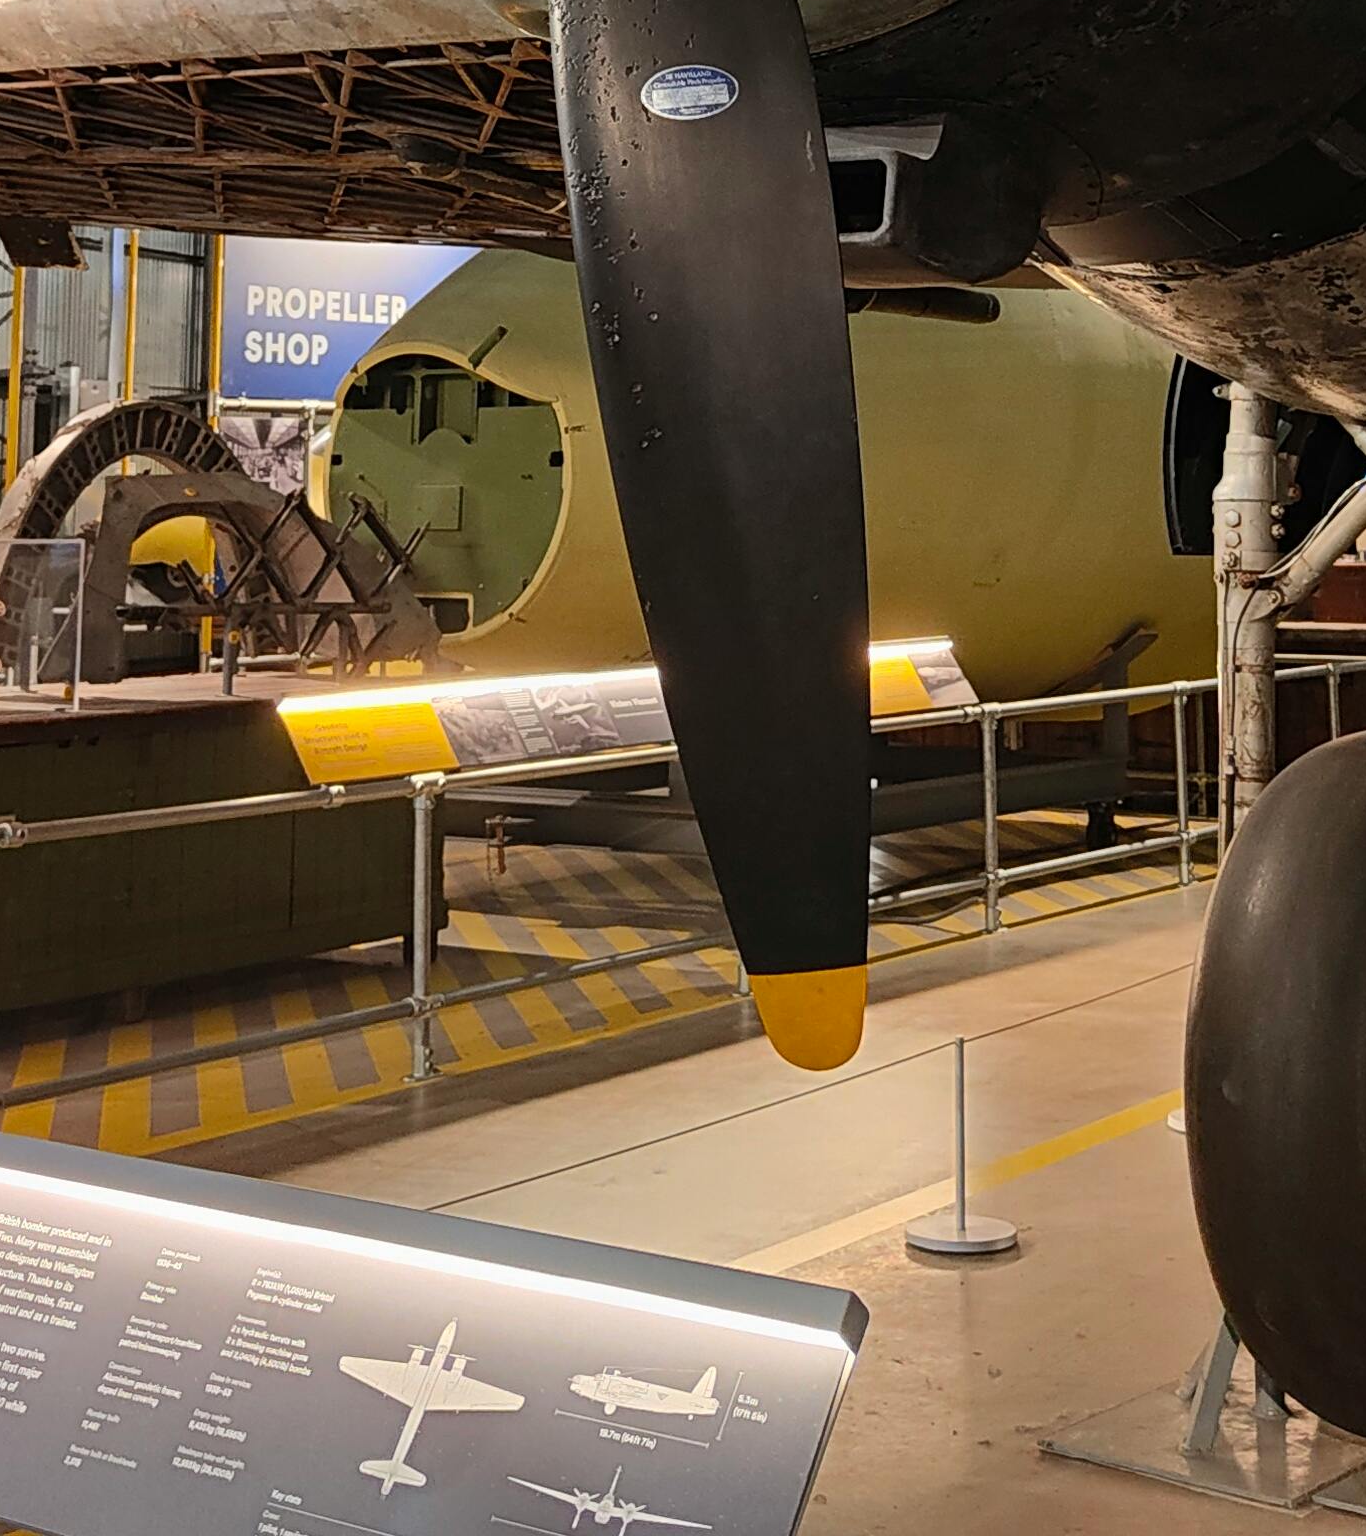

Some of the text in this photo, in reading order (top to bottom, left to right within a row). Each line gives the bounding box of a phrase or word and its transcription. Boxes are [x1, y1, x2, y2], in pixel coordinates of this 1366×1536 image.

[246, 284, 407, 325] PROPELLER
[244, 330, 329, 366] SHOP
[21, 1219, 51, 1234] bomber
[49, 1228, 89, 1242] produced
[87, 1235, 105, 1245] and
[103, 1236, 112, 1247] in
[15, 1235, 38, 1250] Many
[37, 1242, 57, 1253] were
[56, 1246, 99, 1262] assembled
[5, 1251, 41, 1267] designed
[39, 1258, 53, 1270] the
[53, 1260, 95, 1279] Wellington
[27, 1272, 54, 1288] Thanks
[54, 1280, 63, 1289] to
[63, 1281, 74, 1292] its
[3, 1288, 35, 1301] wartime
[34, 1294, 55, 1307] roles,
[56, 1297, 74, 1310] first
[73, 1304, 83, 1312] as
[18, 1309, 35, 1319] and
[33, 1312, 43, 1322] as
[50, 1315, 77, 1329] trainer.
[1, 1342, 17, 1354] two
[1, 1360, 19, 1374] first
[18, 1367, 42, 1380] major
[7, 1381, 19, 1392] of
[5, 1400, 27, 1413] while
[271, 1489, 302, 1505] Key data
